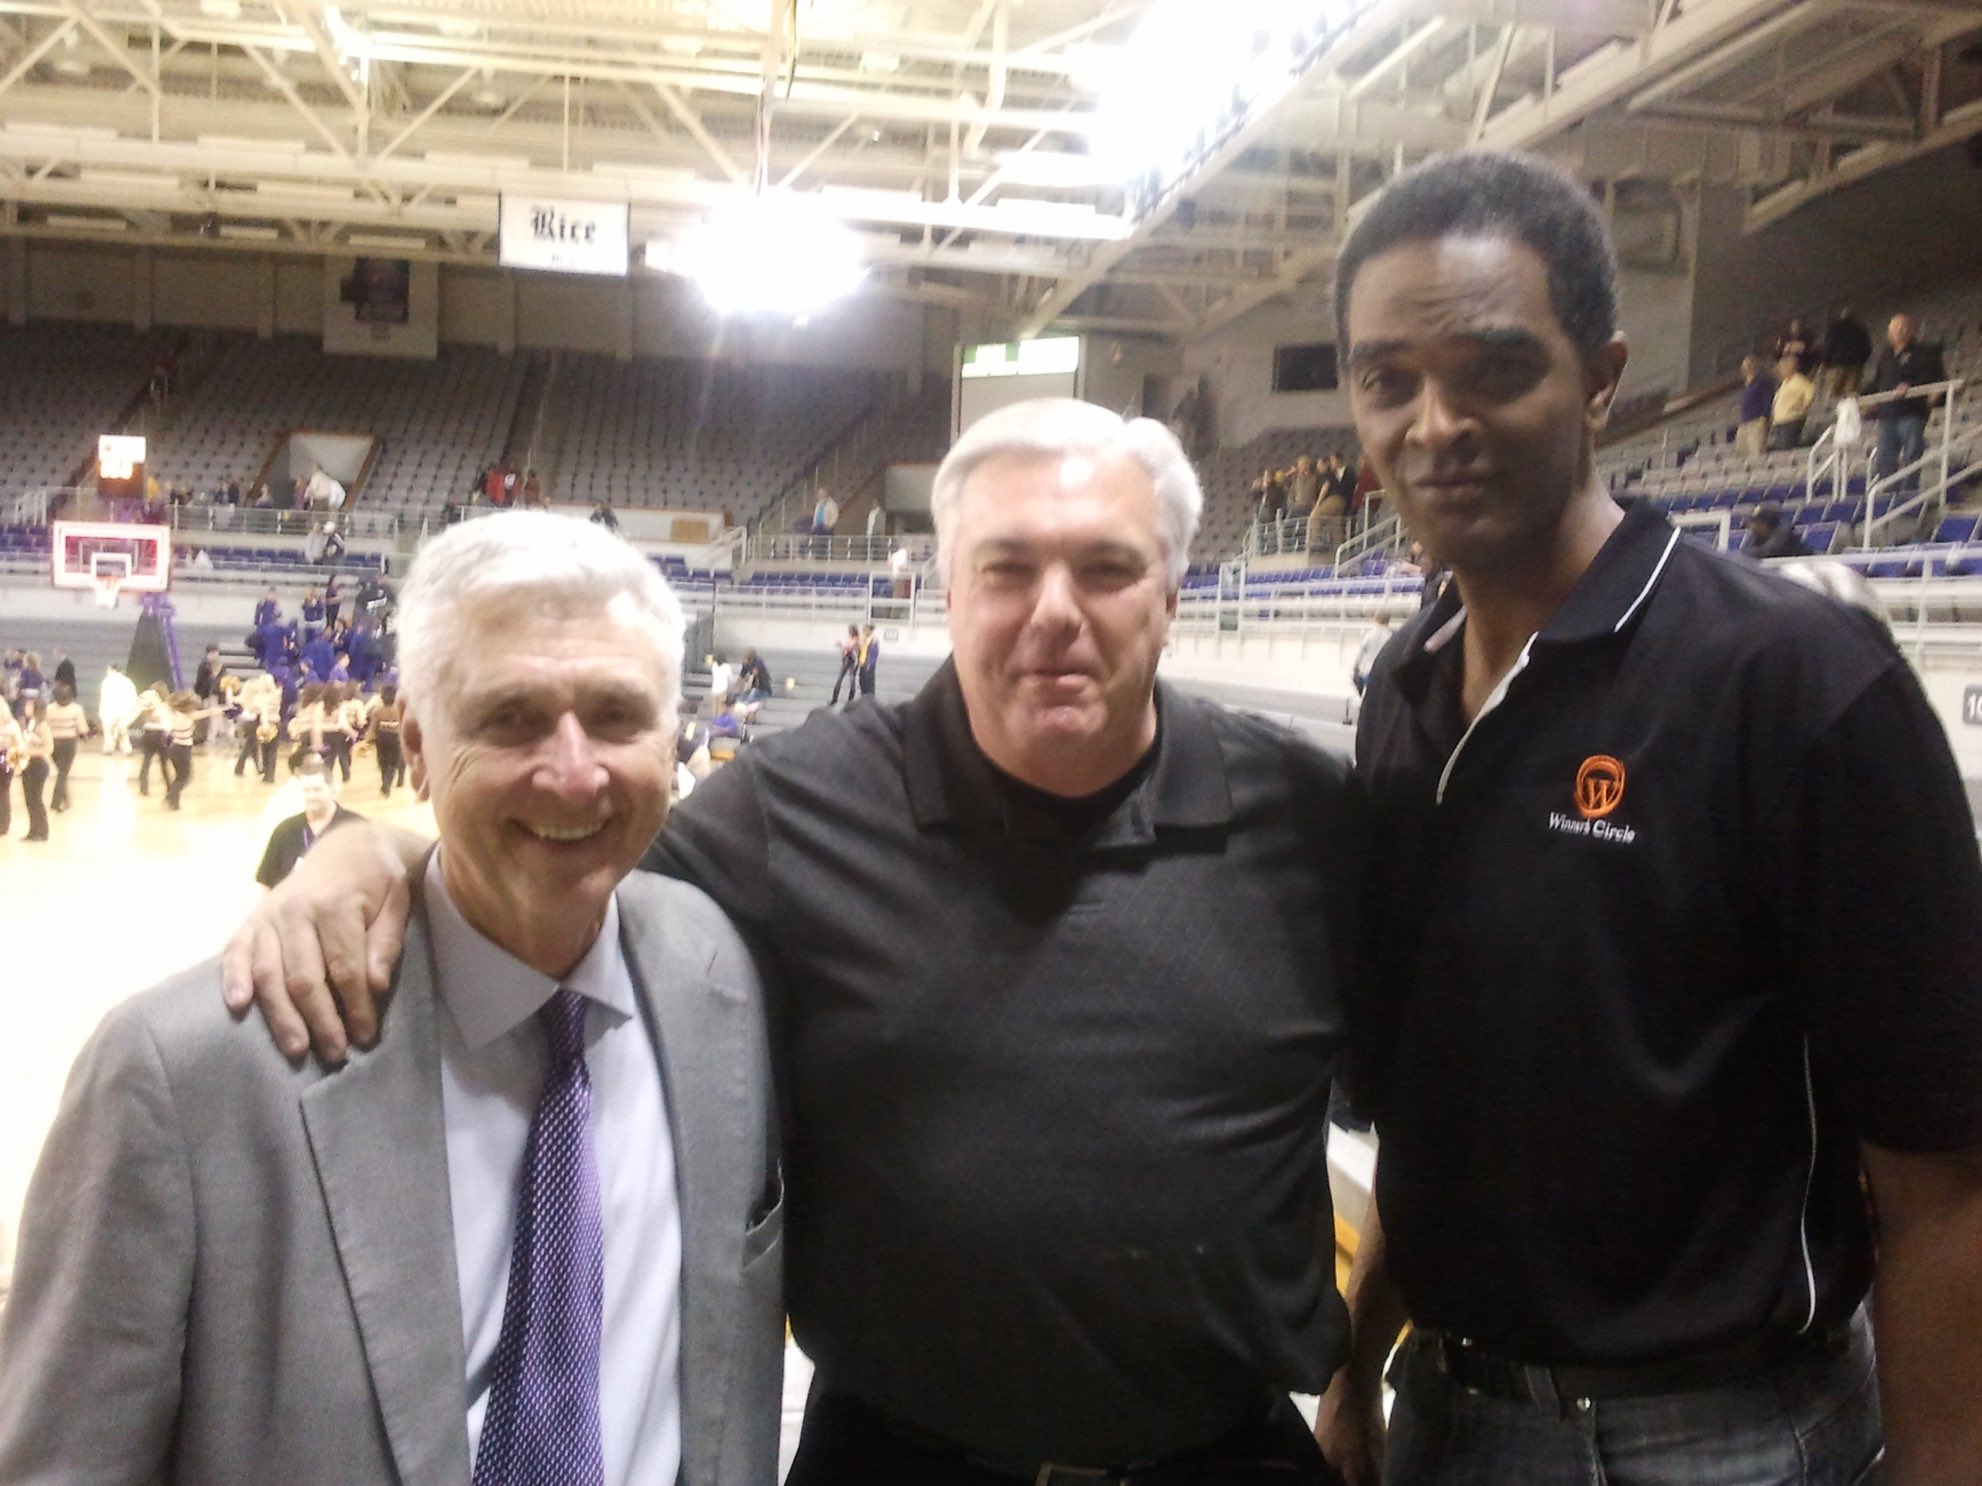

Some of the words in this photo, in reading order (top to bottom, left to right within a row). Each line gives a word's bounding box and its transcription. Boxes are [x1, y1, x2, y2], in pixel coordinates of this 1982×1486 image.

[531, 205, 596, 244] Rice
[1584, 777, 1620, 810] W
[1592, 819, 1636, 843] Circle
